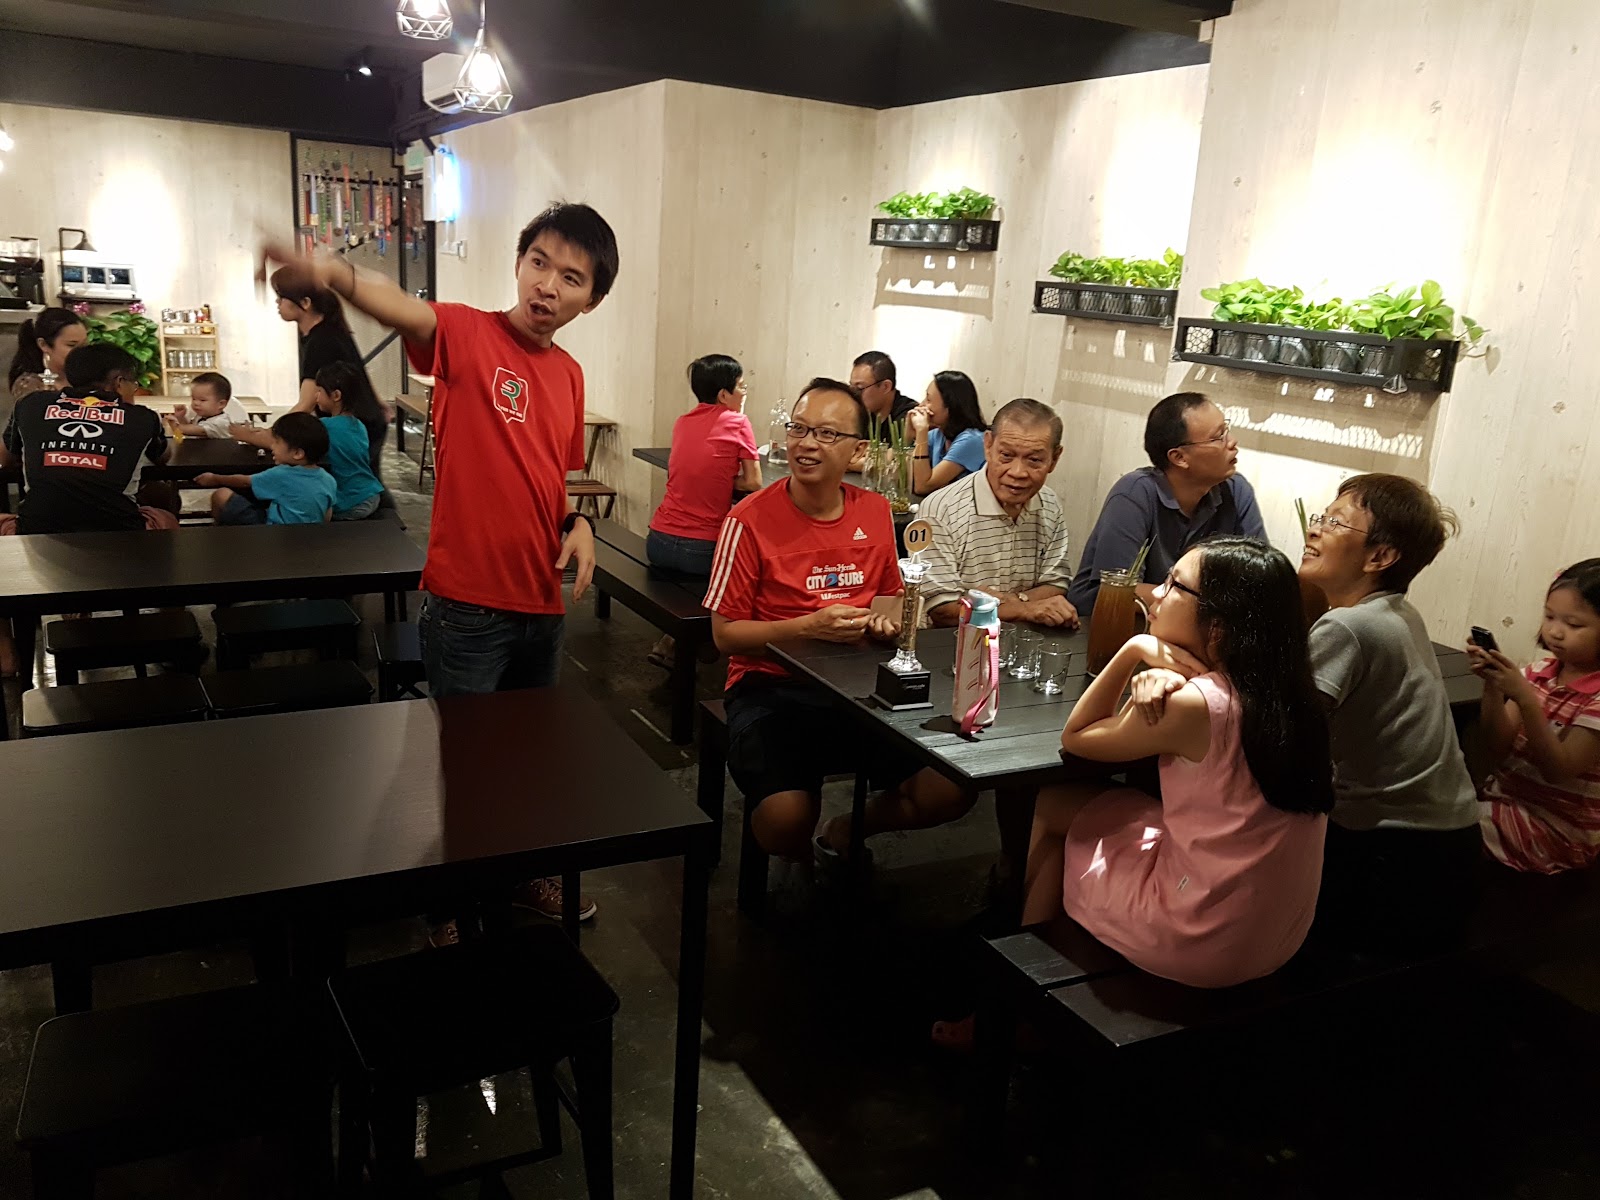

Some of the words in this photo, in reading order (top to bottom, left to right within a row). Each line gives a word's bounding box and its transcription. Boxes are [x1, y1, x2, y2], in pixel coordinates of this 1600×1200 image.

[44, 405, 85, 420] Red
[84, 407, 125, 425] Bull
[41, 441, 114, 455] INFINITI
[47, 453, 103, 467] TOTAL
[909, 528, 926, 543] 01
